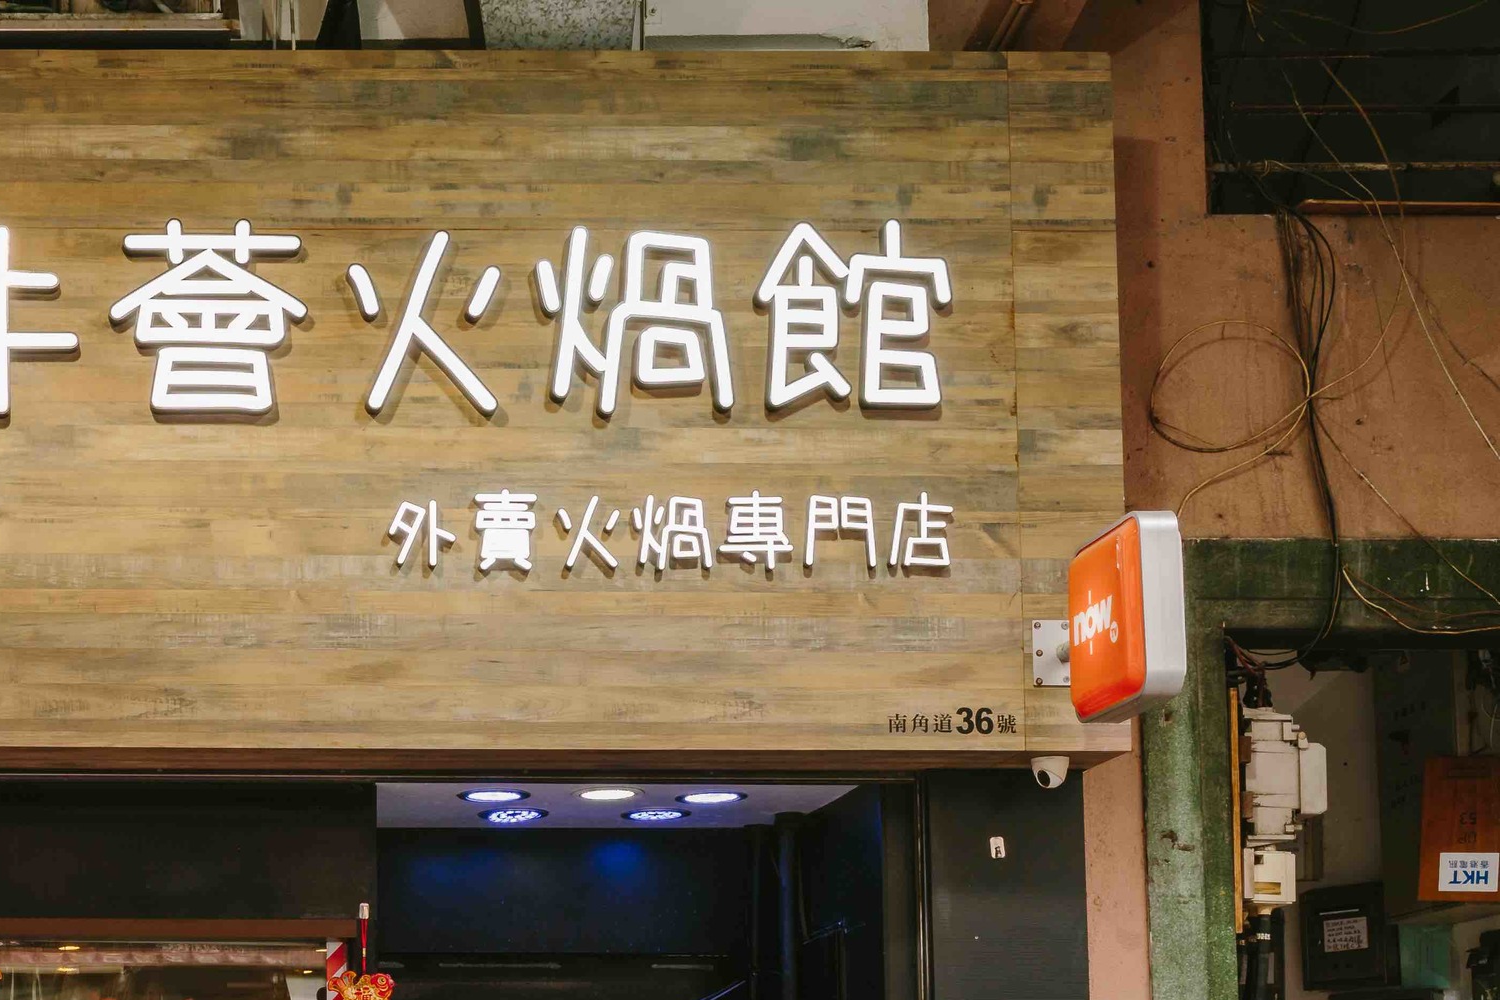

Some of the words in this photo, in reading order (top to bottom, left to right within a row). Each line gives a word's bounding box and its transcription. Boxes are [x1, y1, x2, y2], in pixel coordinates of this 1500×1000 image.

[1073, 594, 1113, 648] now
[887, 707, 1017, 735] 南角道36號
[1448, 870, 1489, 884] HKT
